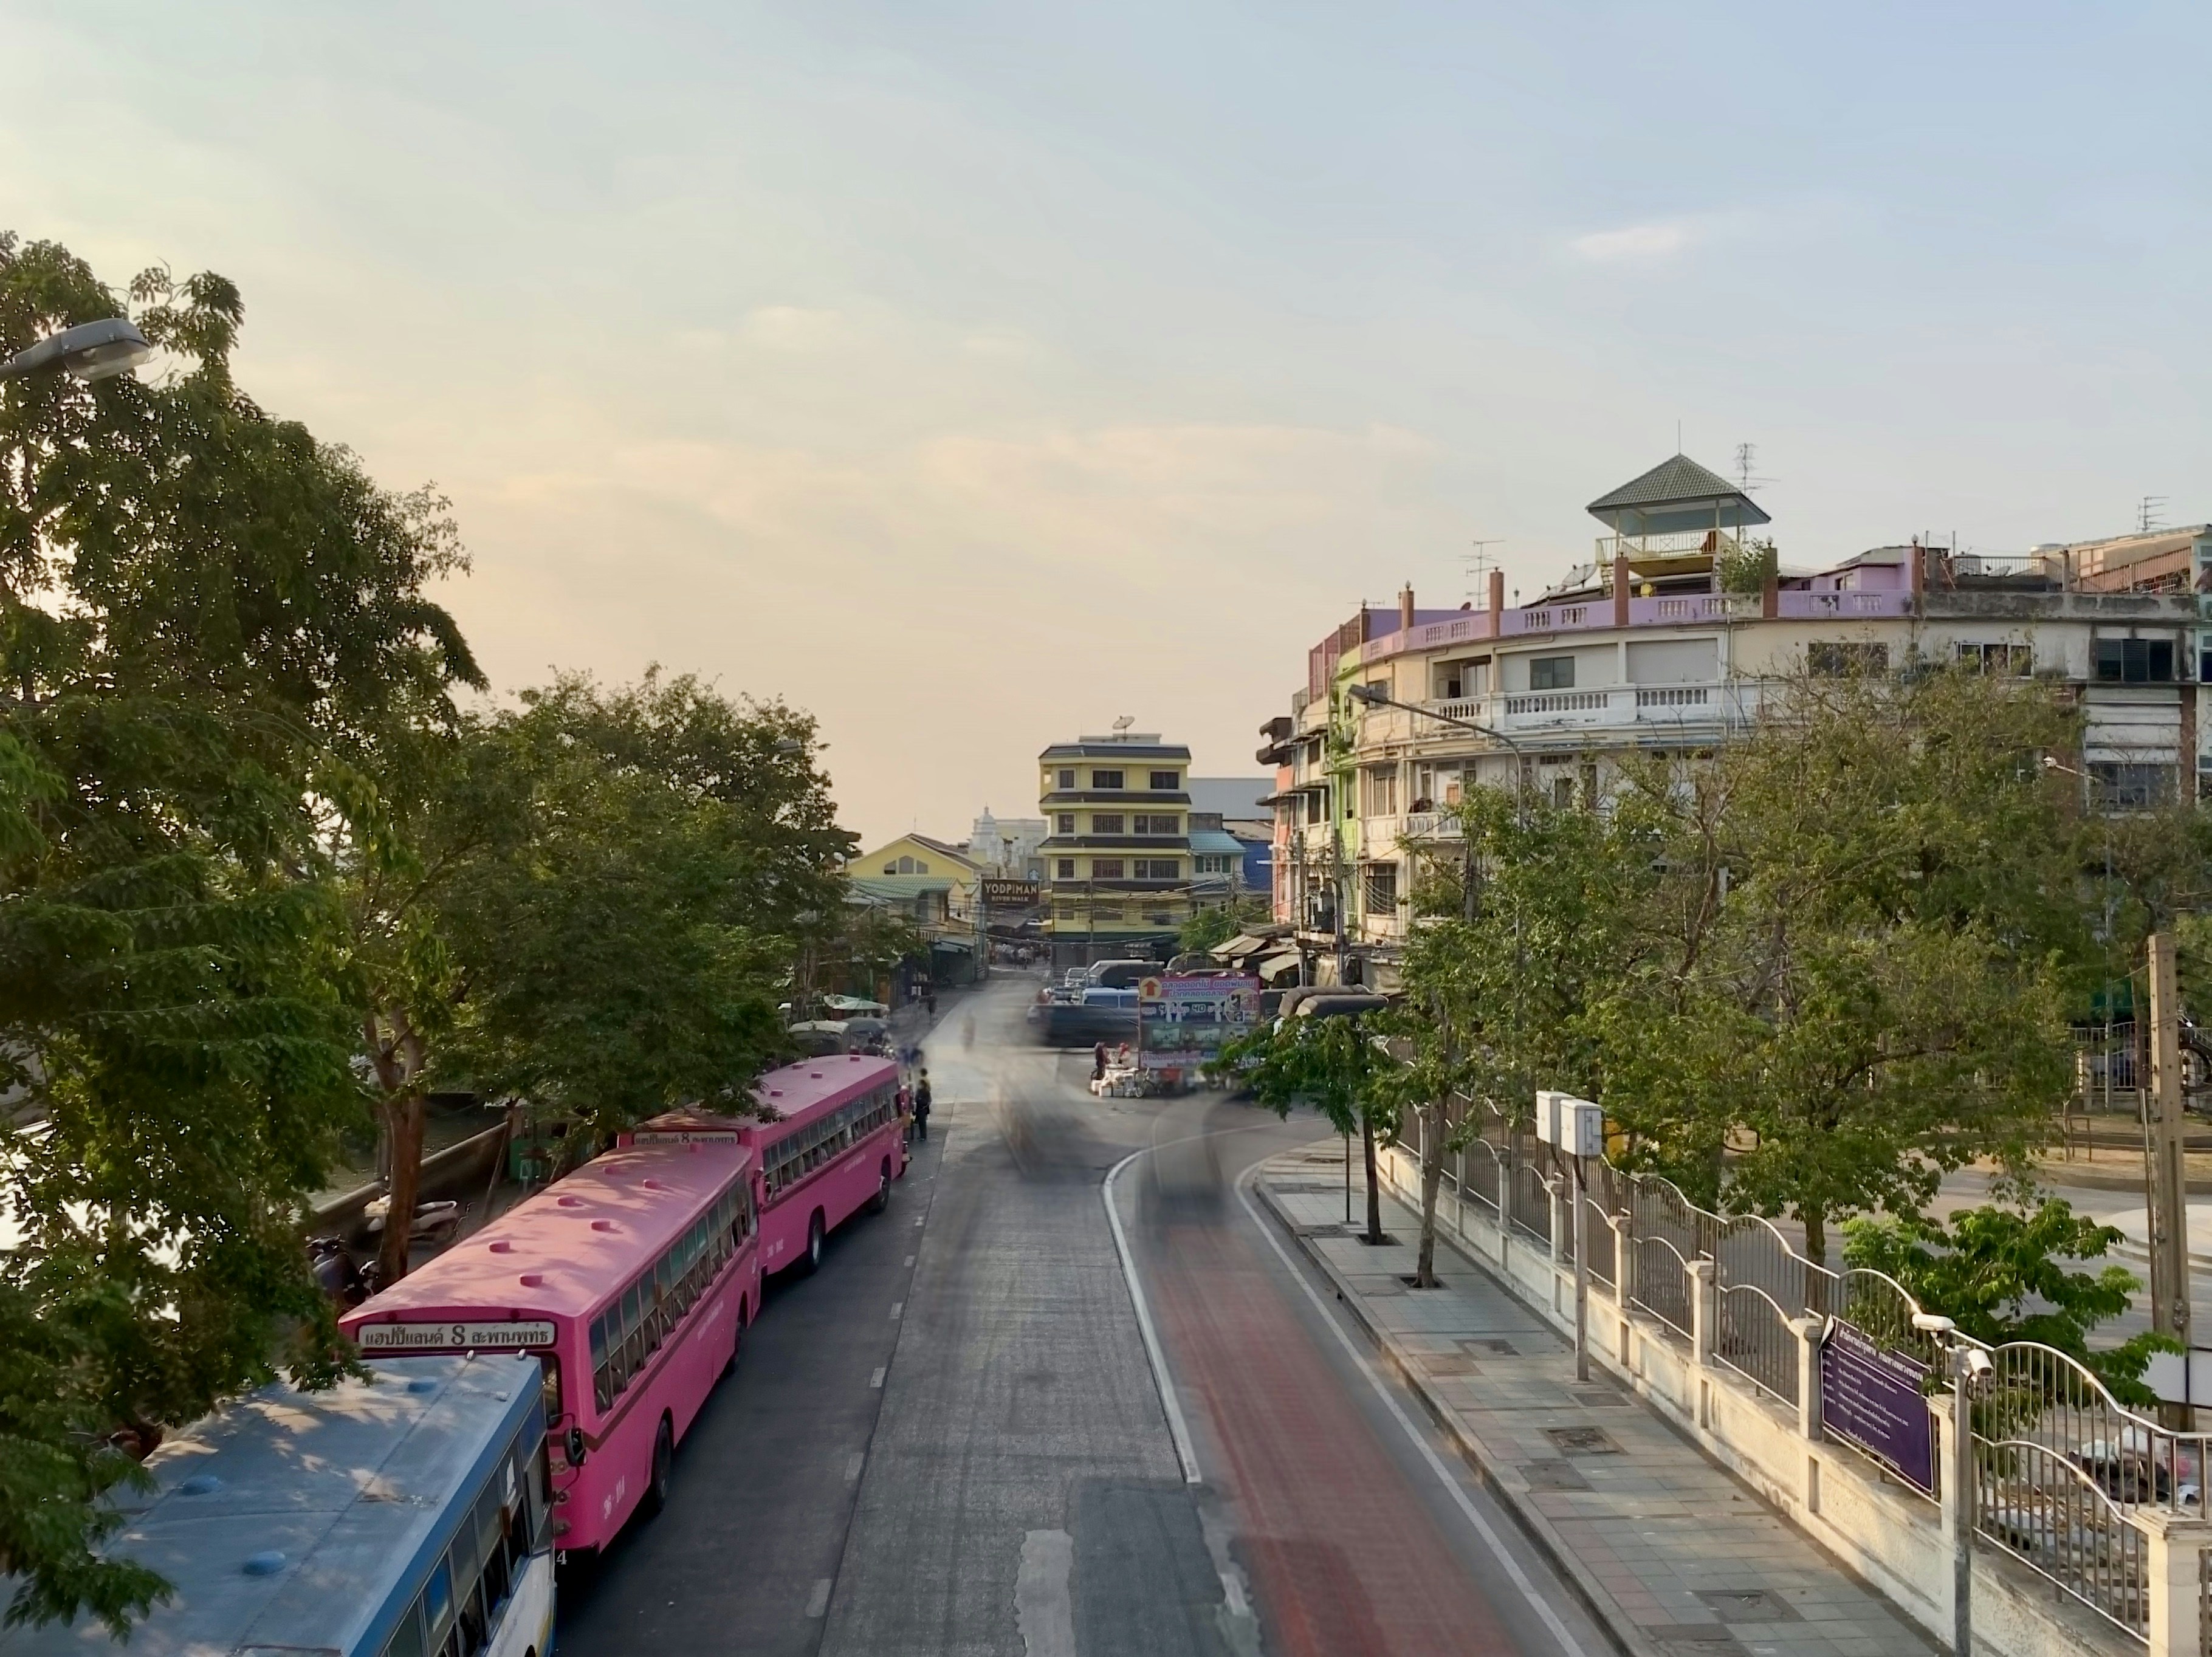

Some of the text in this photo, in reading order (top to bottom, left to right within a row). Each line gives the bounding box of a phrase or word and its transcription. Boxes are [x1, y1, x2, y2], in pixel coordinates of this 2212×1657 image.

[985, 883, 1037, 894] YODPIMAN
[1159, 1004, 1166, 1014] 4
[1192, 1004, 1206, 1013] 40
[681, 1132, 690, 1143] 8
[365, 1326, 444, 1345] แฮปปี้แลนด์
